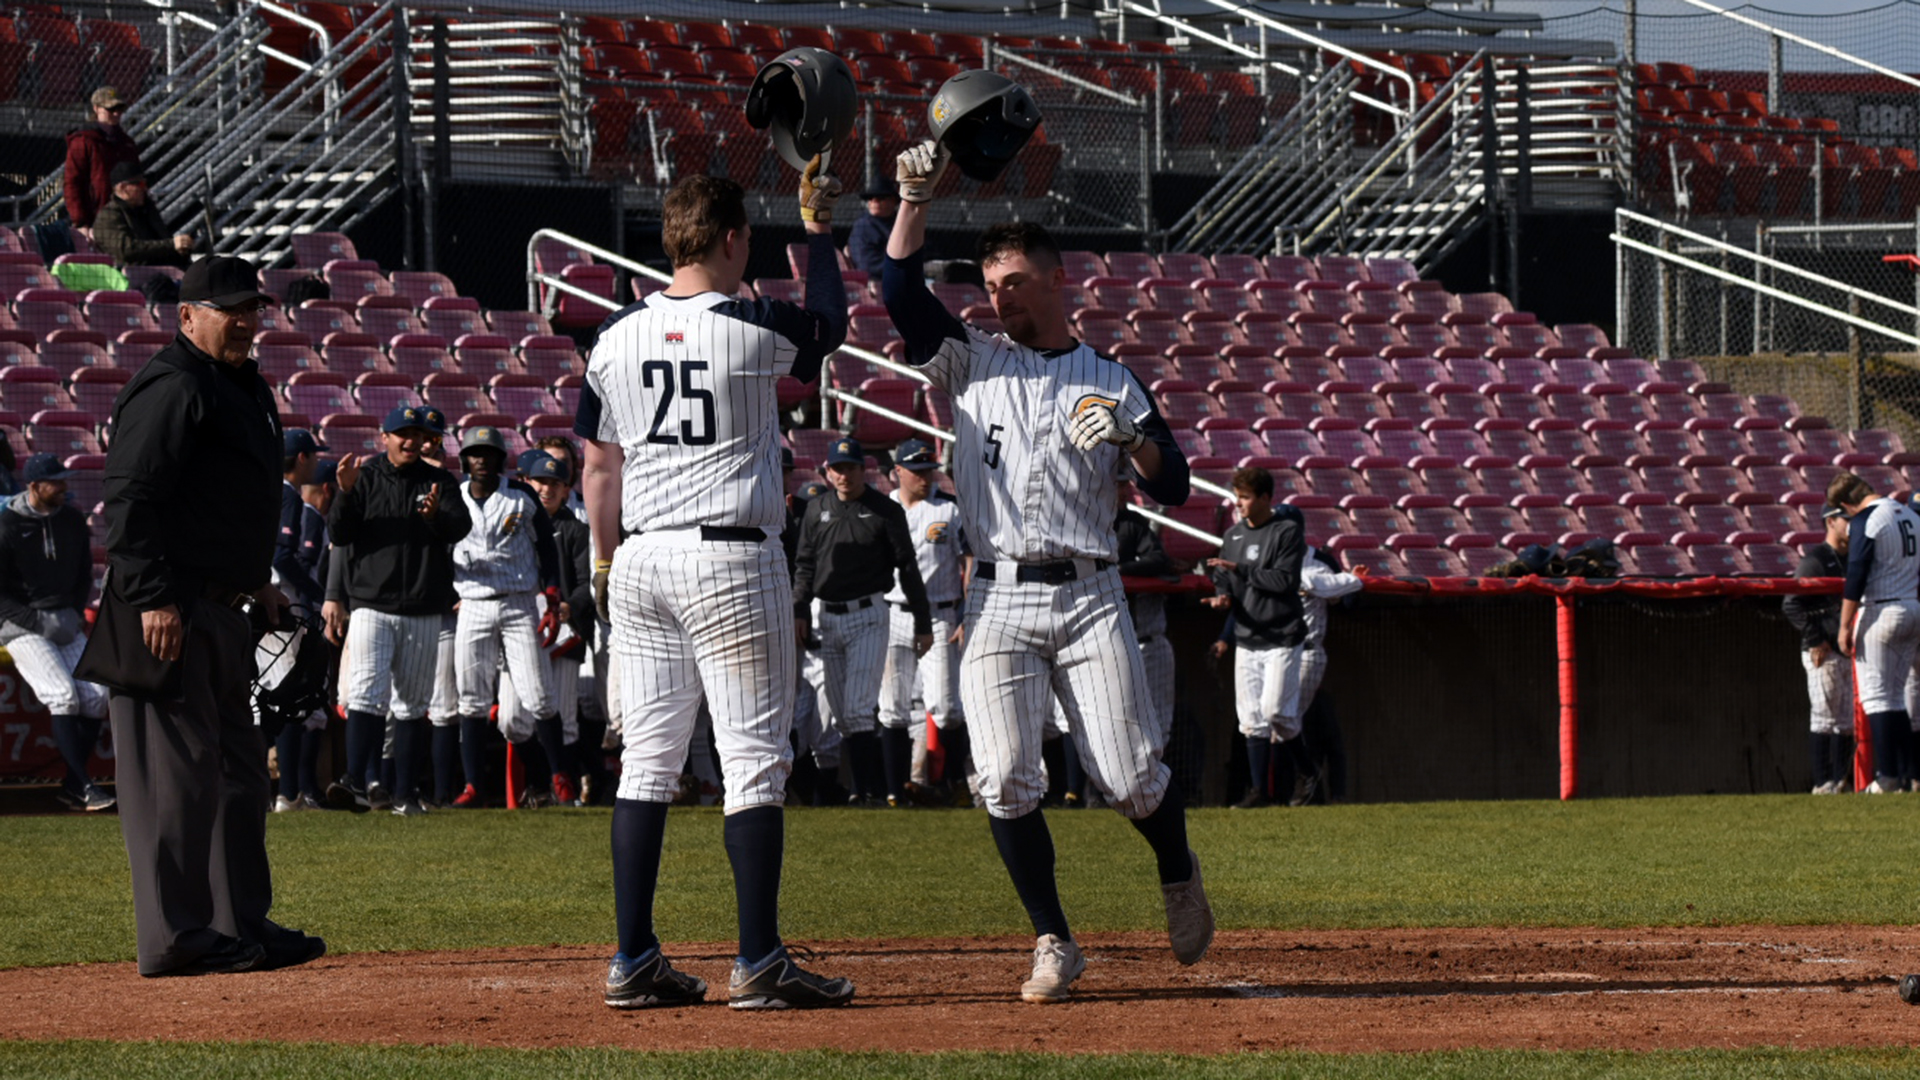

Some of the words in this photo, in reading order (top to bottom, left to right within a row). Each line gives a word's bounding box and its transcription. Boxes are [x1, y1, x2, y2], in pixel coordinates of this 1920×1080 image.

[642, 360, 716, 446] 25
[984, 423, 1005, 470] 5
[1898, 519, 1917, 558] 16
